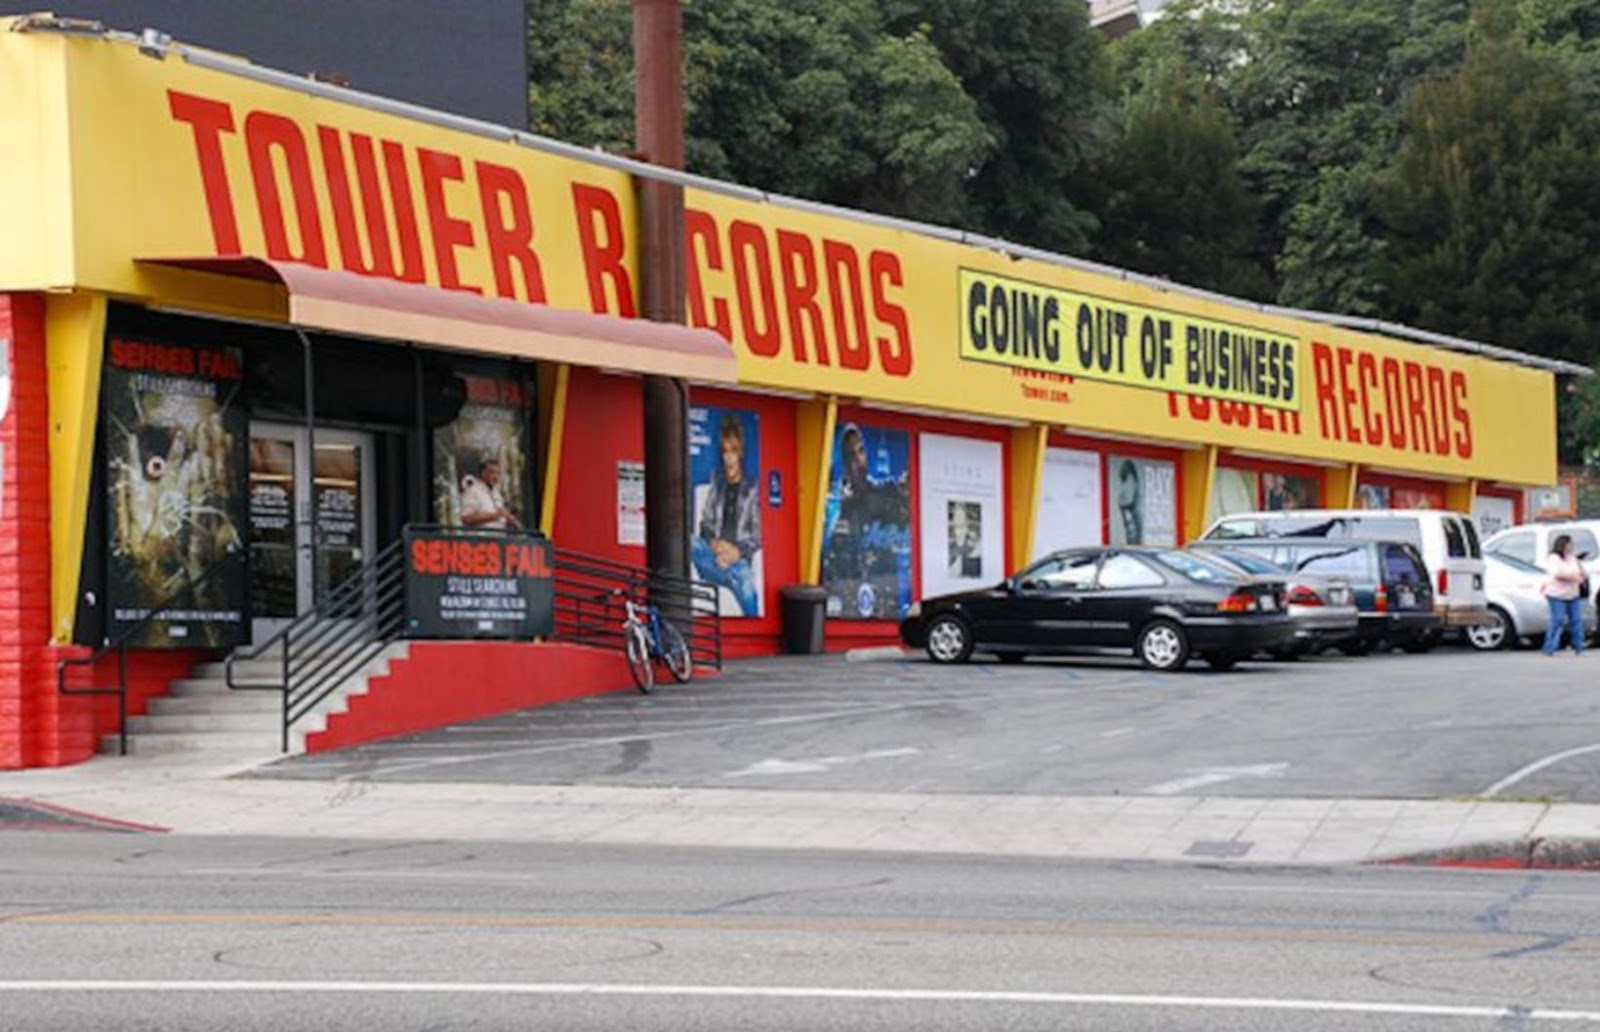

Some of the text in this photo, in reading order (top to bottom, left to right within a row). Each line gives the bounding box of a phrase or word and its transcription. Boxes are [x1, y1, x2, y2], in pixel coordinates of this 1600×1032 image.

[168, 90, 912, 377] TOWER RCORDS
[968, 280, 1295, 403] GOING OUT OF BUSINESS
[1312, 343, 1473, 458] RECORDS
[412, 539, 552, 579] SENSES FAIL
